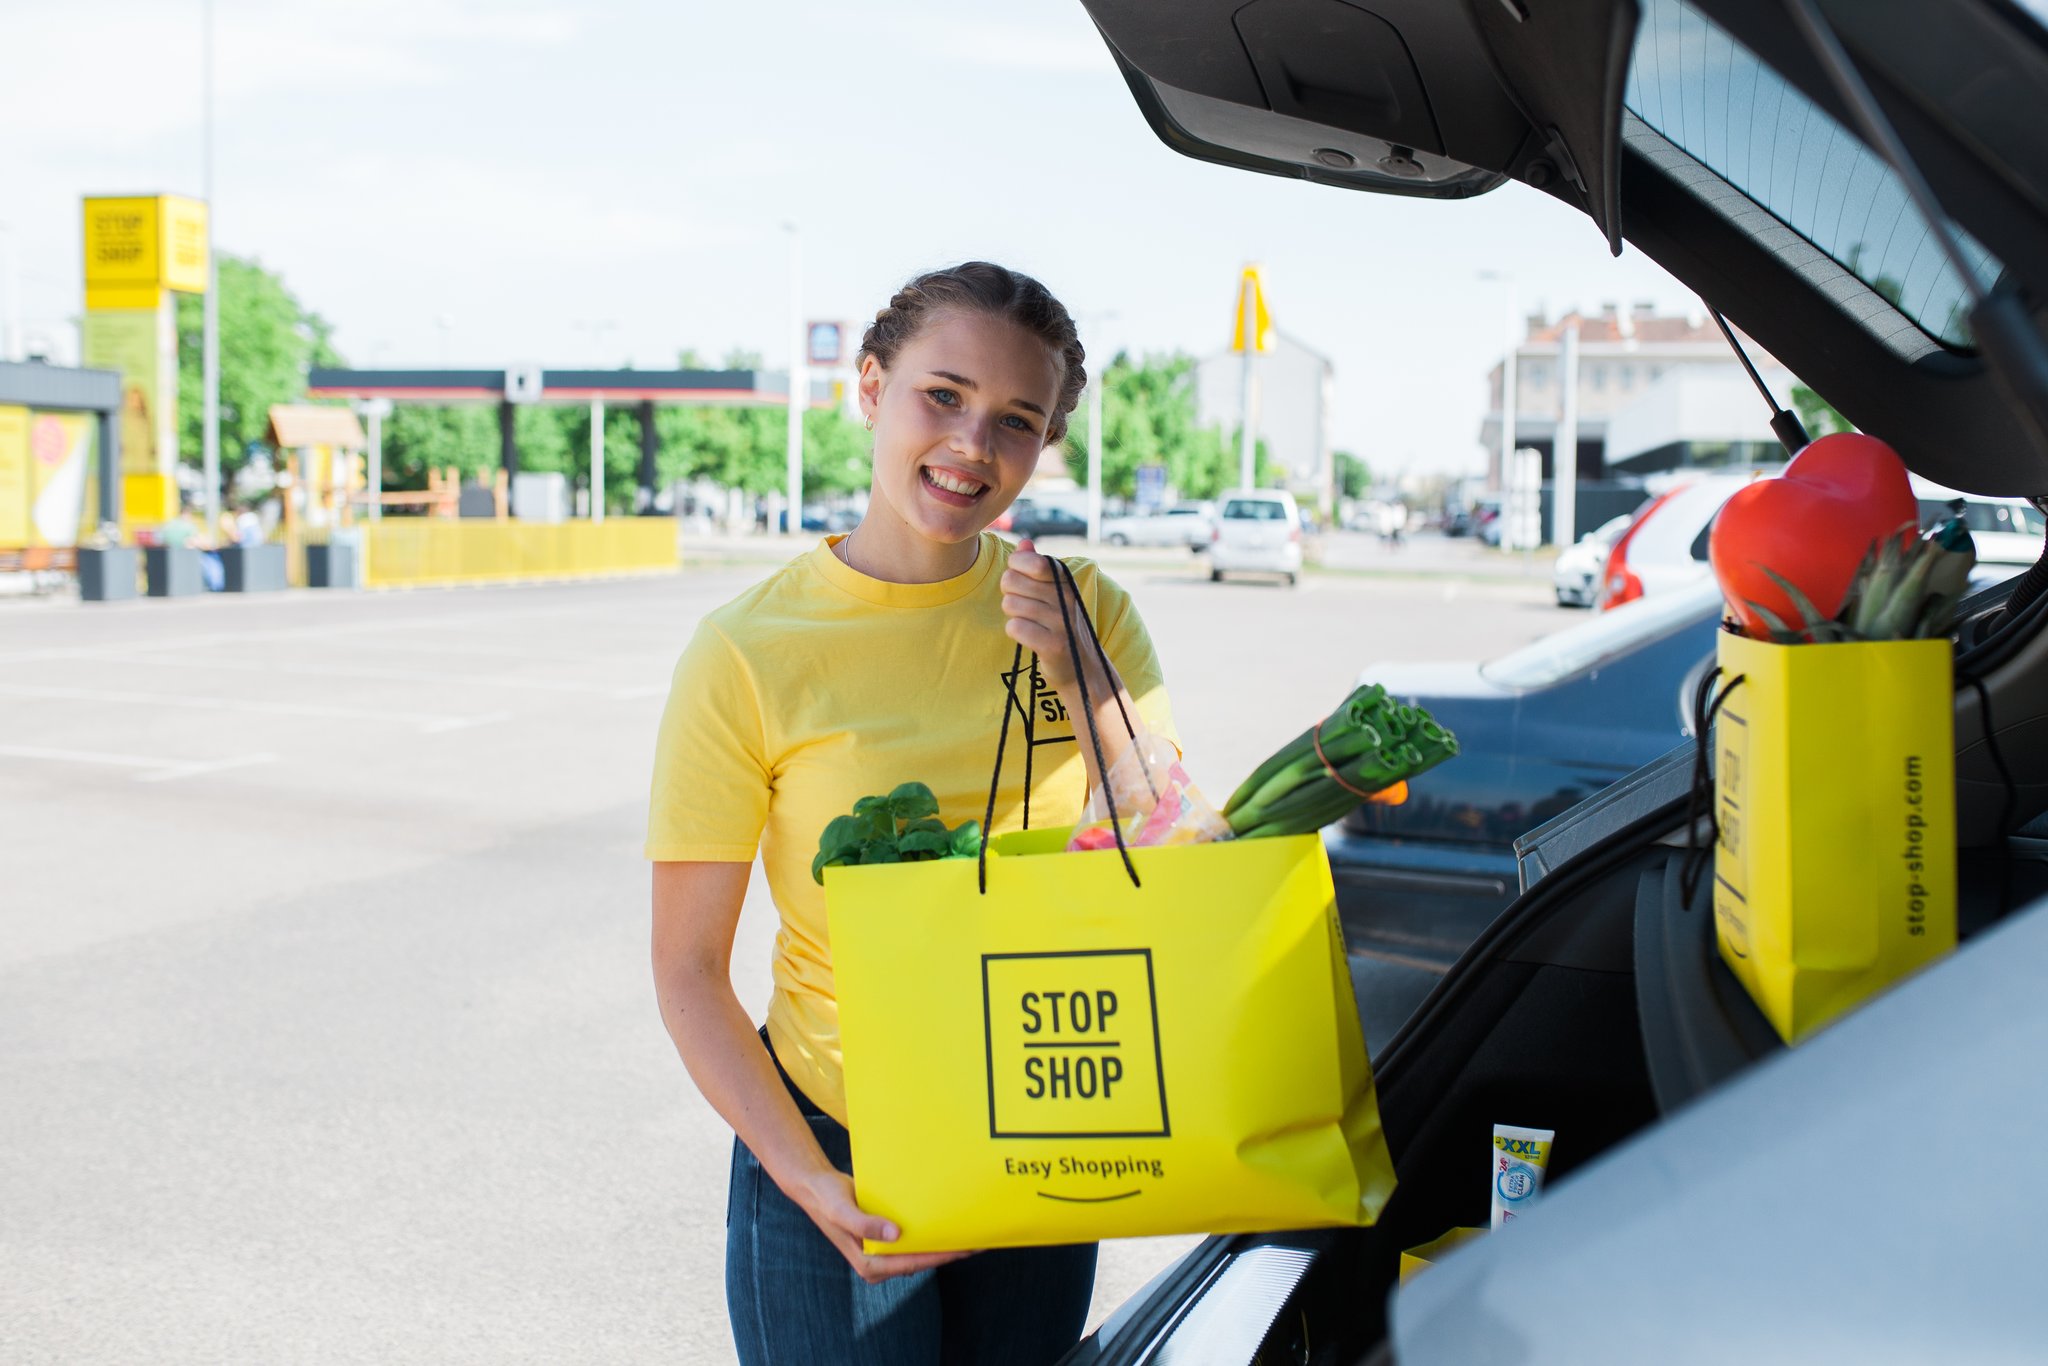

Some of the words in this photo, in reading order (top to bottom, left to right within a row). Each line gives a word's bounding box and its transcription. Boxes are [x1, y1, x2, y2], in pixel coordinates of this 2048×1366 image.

[1040, 698, 1070, 722] SH
[1903, 755, 1929, 936] stop-shop.com
[1021, 990, 1118, 1034] STOP
[1025, 1056, 1123, 1099] SHOP
[1502, 1137, 1541, 1155] XXL
[1005, 1157, 1051, 1179] Easy
[1059, 1155, 1164, 1179] Shopping
[1517, 1174, 1525, 1195] CLEAN
